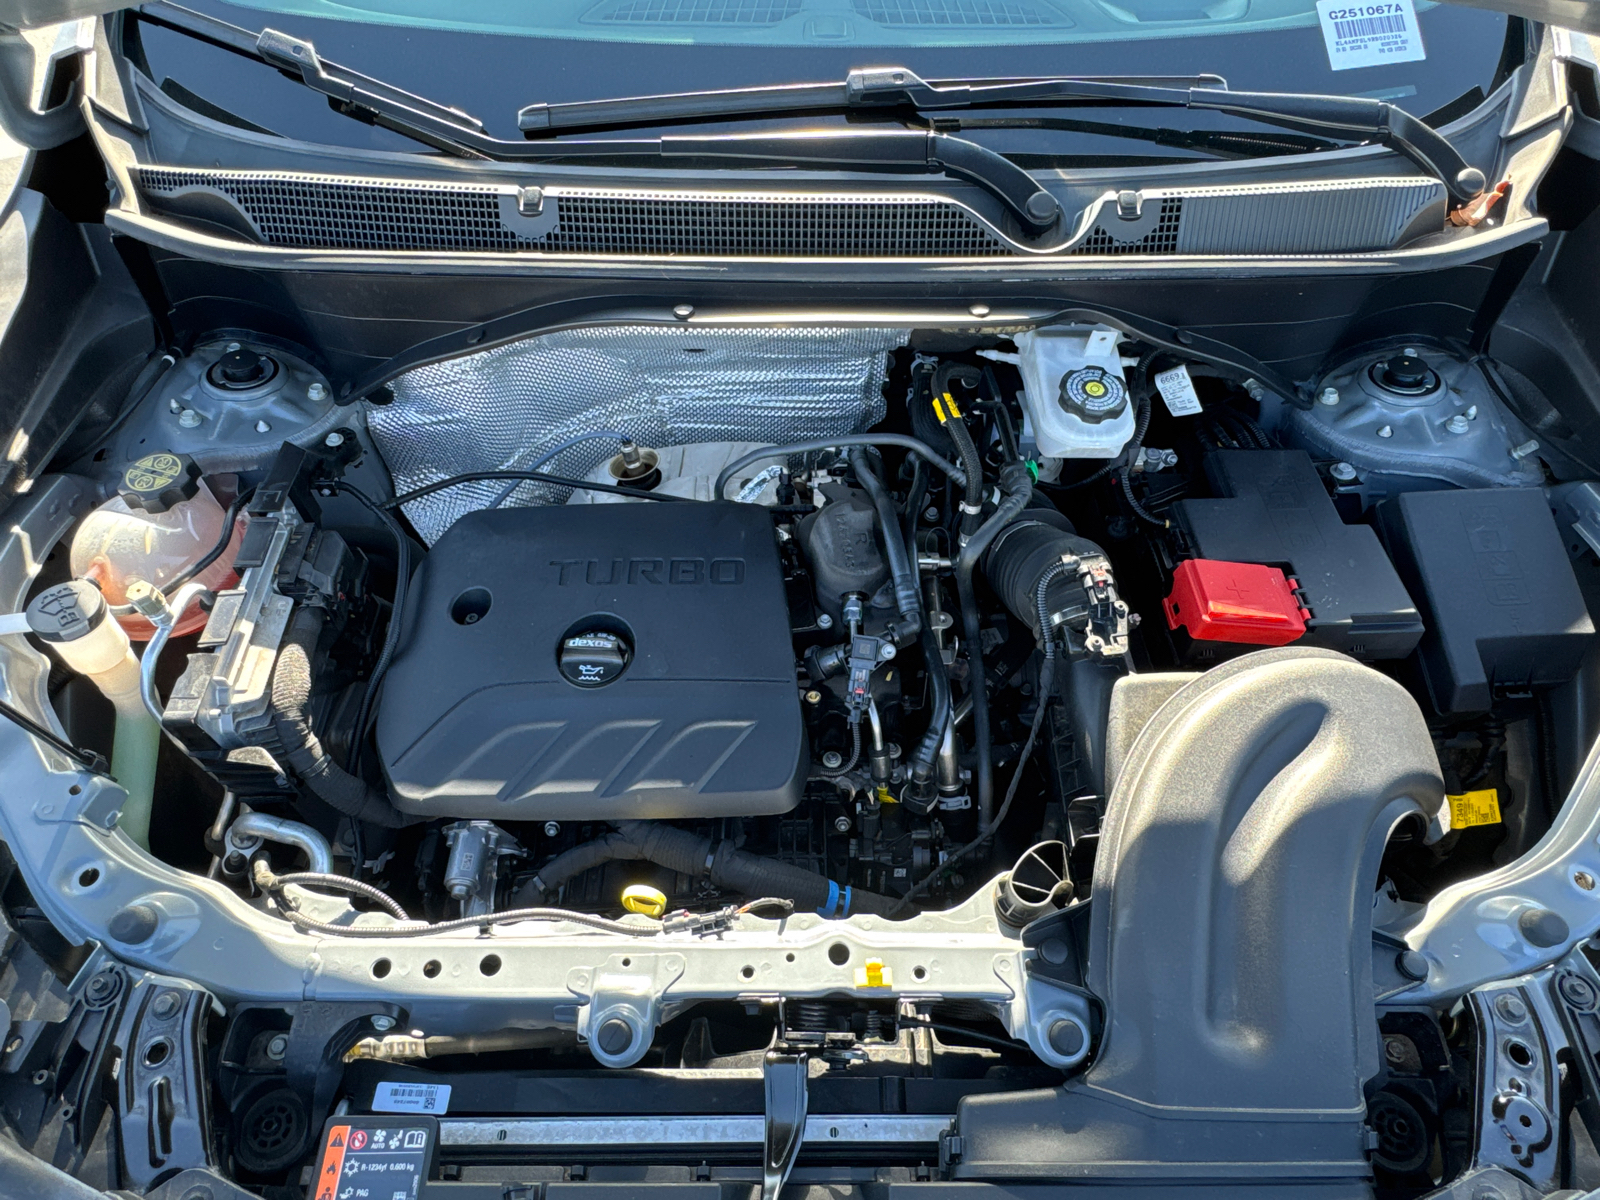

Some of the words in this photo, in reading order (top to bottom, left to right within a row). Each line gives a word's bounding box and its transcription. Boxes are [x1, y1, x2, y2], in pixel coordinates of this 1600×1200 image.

[1328, 4, 1404, 20] G251067A
[549, 557, 746, 586] TURBO
[569, 637, 613, 649] dexos
[370, 1142, 386, 1150] AUTO
[361, 1163, 388, 1173] R-1234yf
[389, 1163, 406, 1171] 0.600
[406, 1163, 415, 1172] kg
[356, 1188, 370, 1198] PAG
